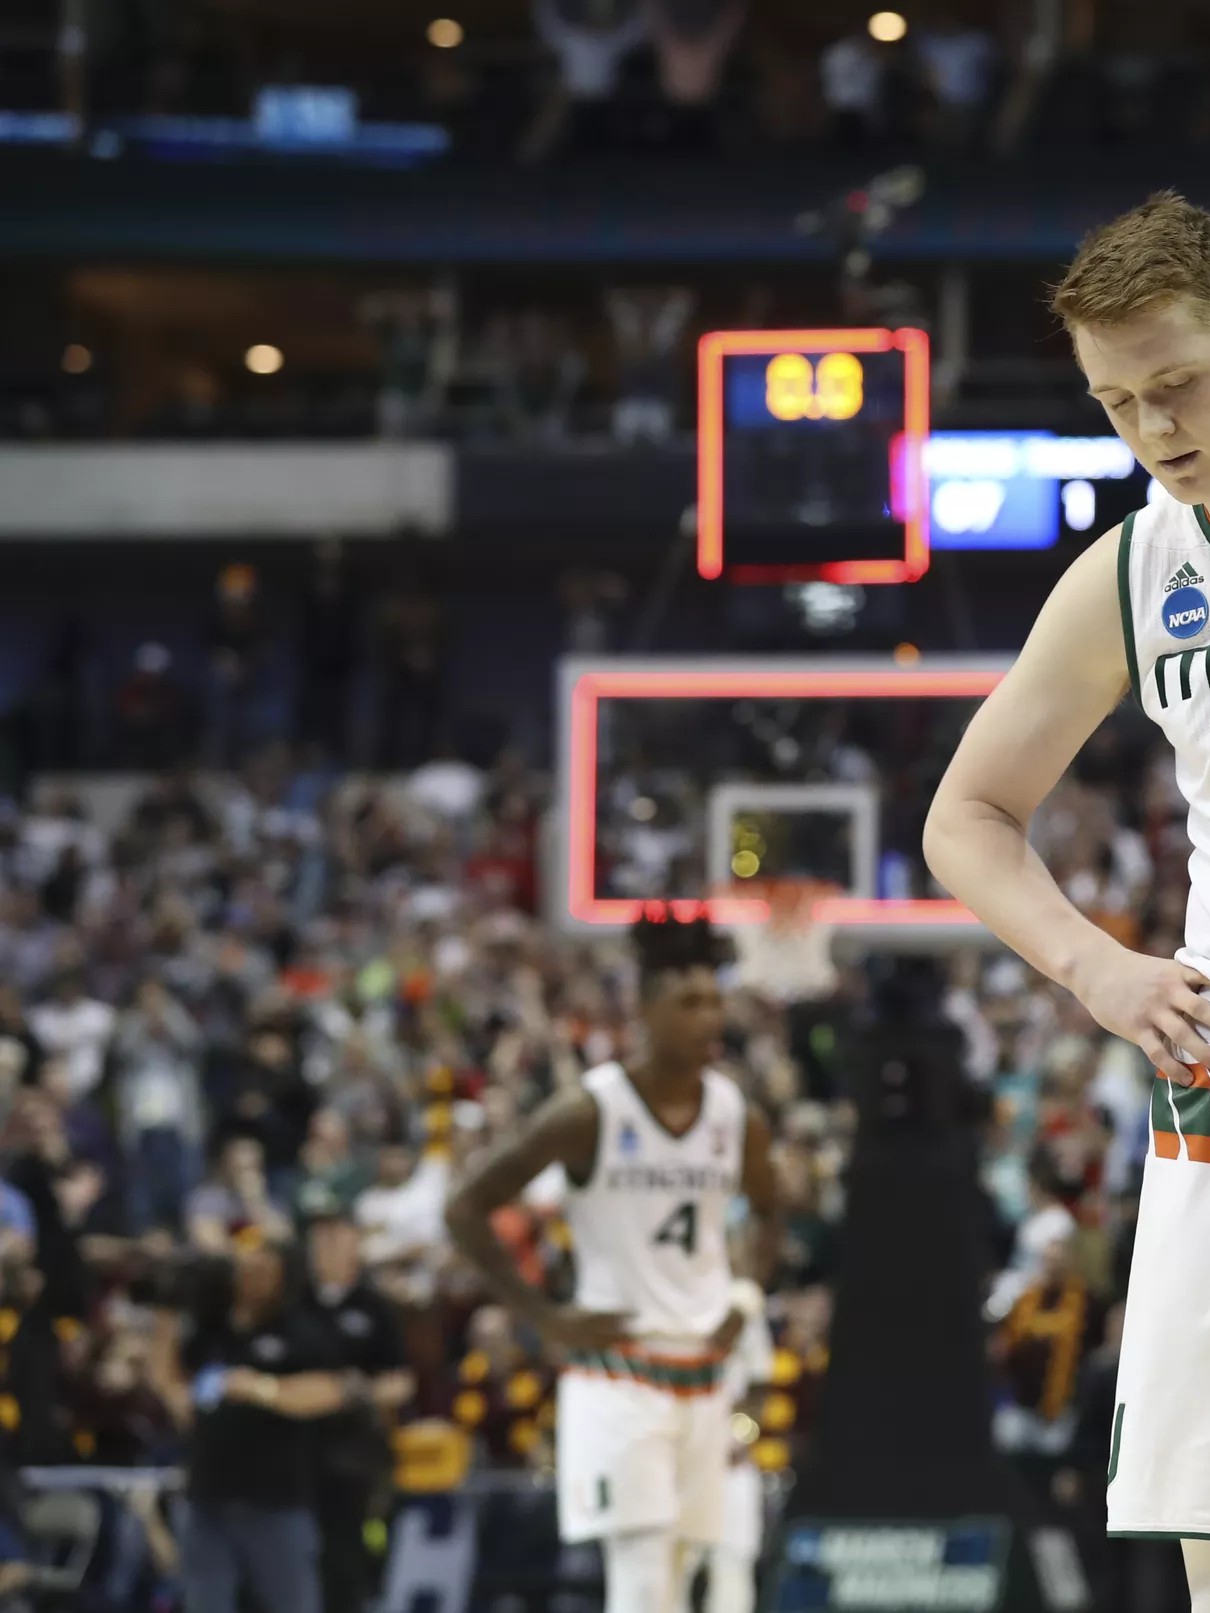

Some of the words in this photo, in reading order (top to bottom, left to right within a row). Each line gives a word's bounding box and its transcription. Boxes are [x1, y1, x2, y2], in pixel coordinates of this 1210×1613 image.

[1164, 575, 1205, 593] adidas
[1168, 606, 1206, 628] NCAA
[653, 1202, 697, 1257] 4
